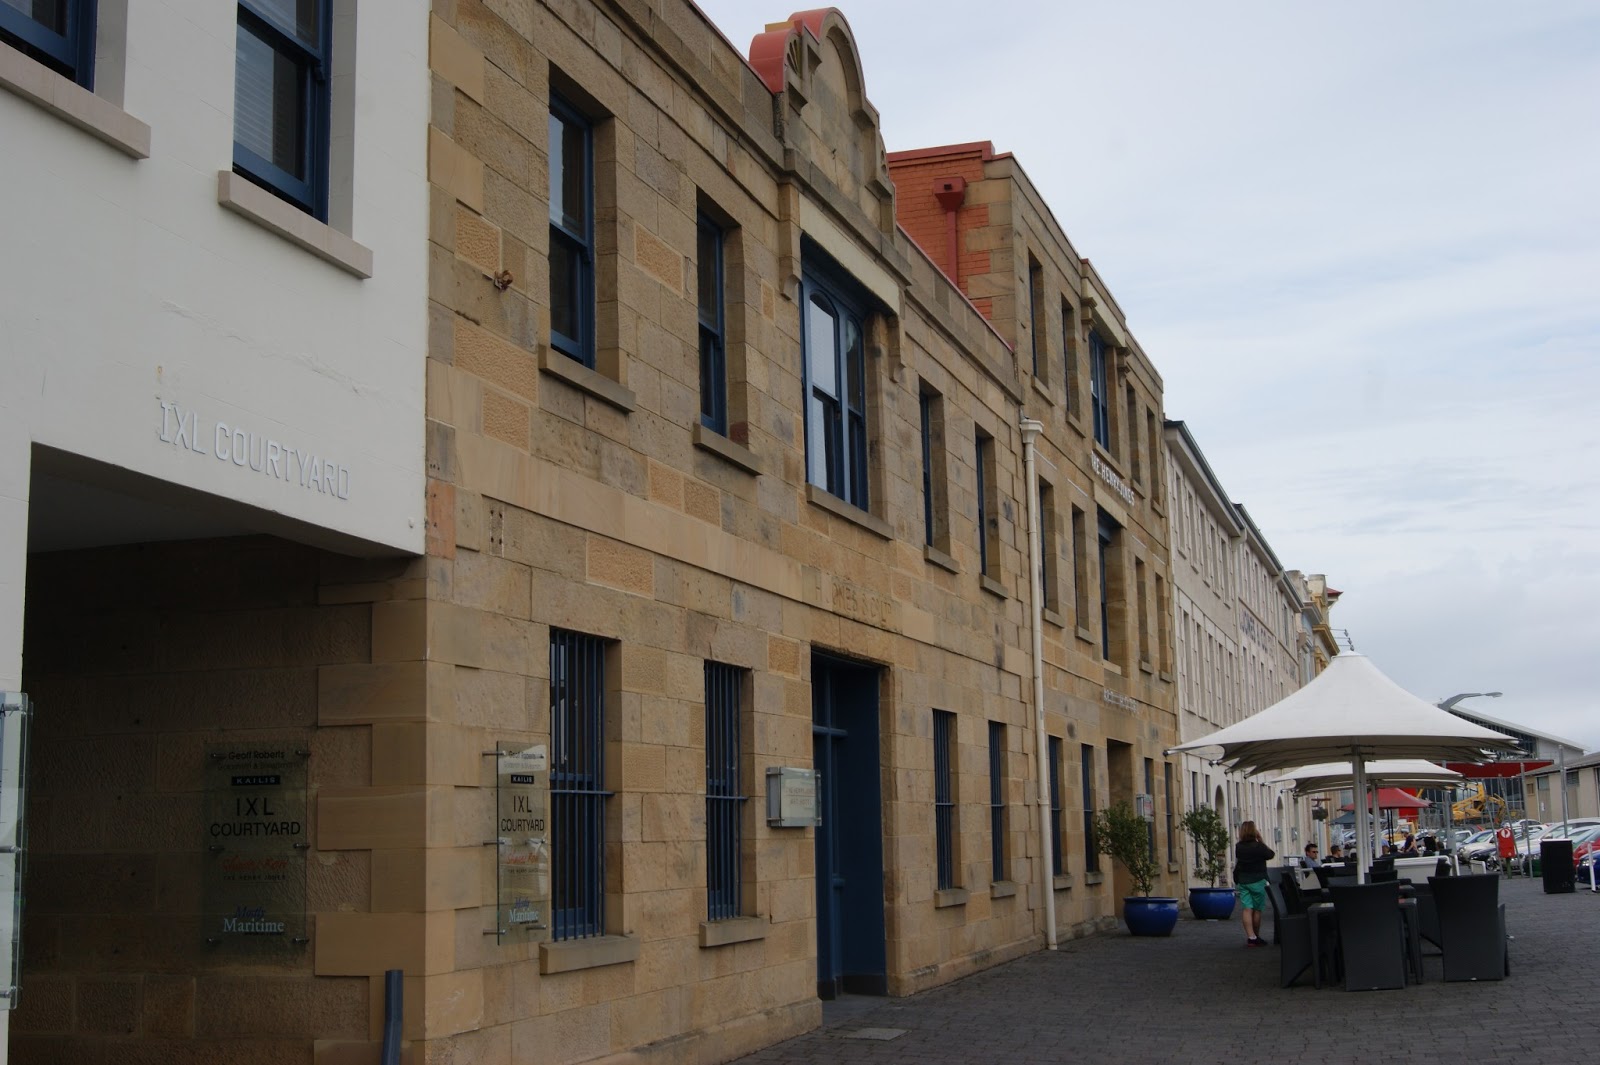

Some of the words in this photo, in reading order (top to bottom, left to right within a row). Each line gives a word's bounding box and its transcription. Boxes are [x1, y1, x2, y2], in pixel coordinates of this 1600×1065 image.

[159, 401, 206, 454] IXL
[214, 421, 350, 500] COURTYARD
[236, 776, 276, 784] KAILIS
[512, 775, 533, 783] KAILIS
[236, 798, 275, 816] IXL
[513, 795, 532, 813] IXL
[210, 822, 301, 837] COURTYARD
[501, 818, 545, 832] COURTYARD
[223, 917, 285, 932] Maritime
